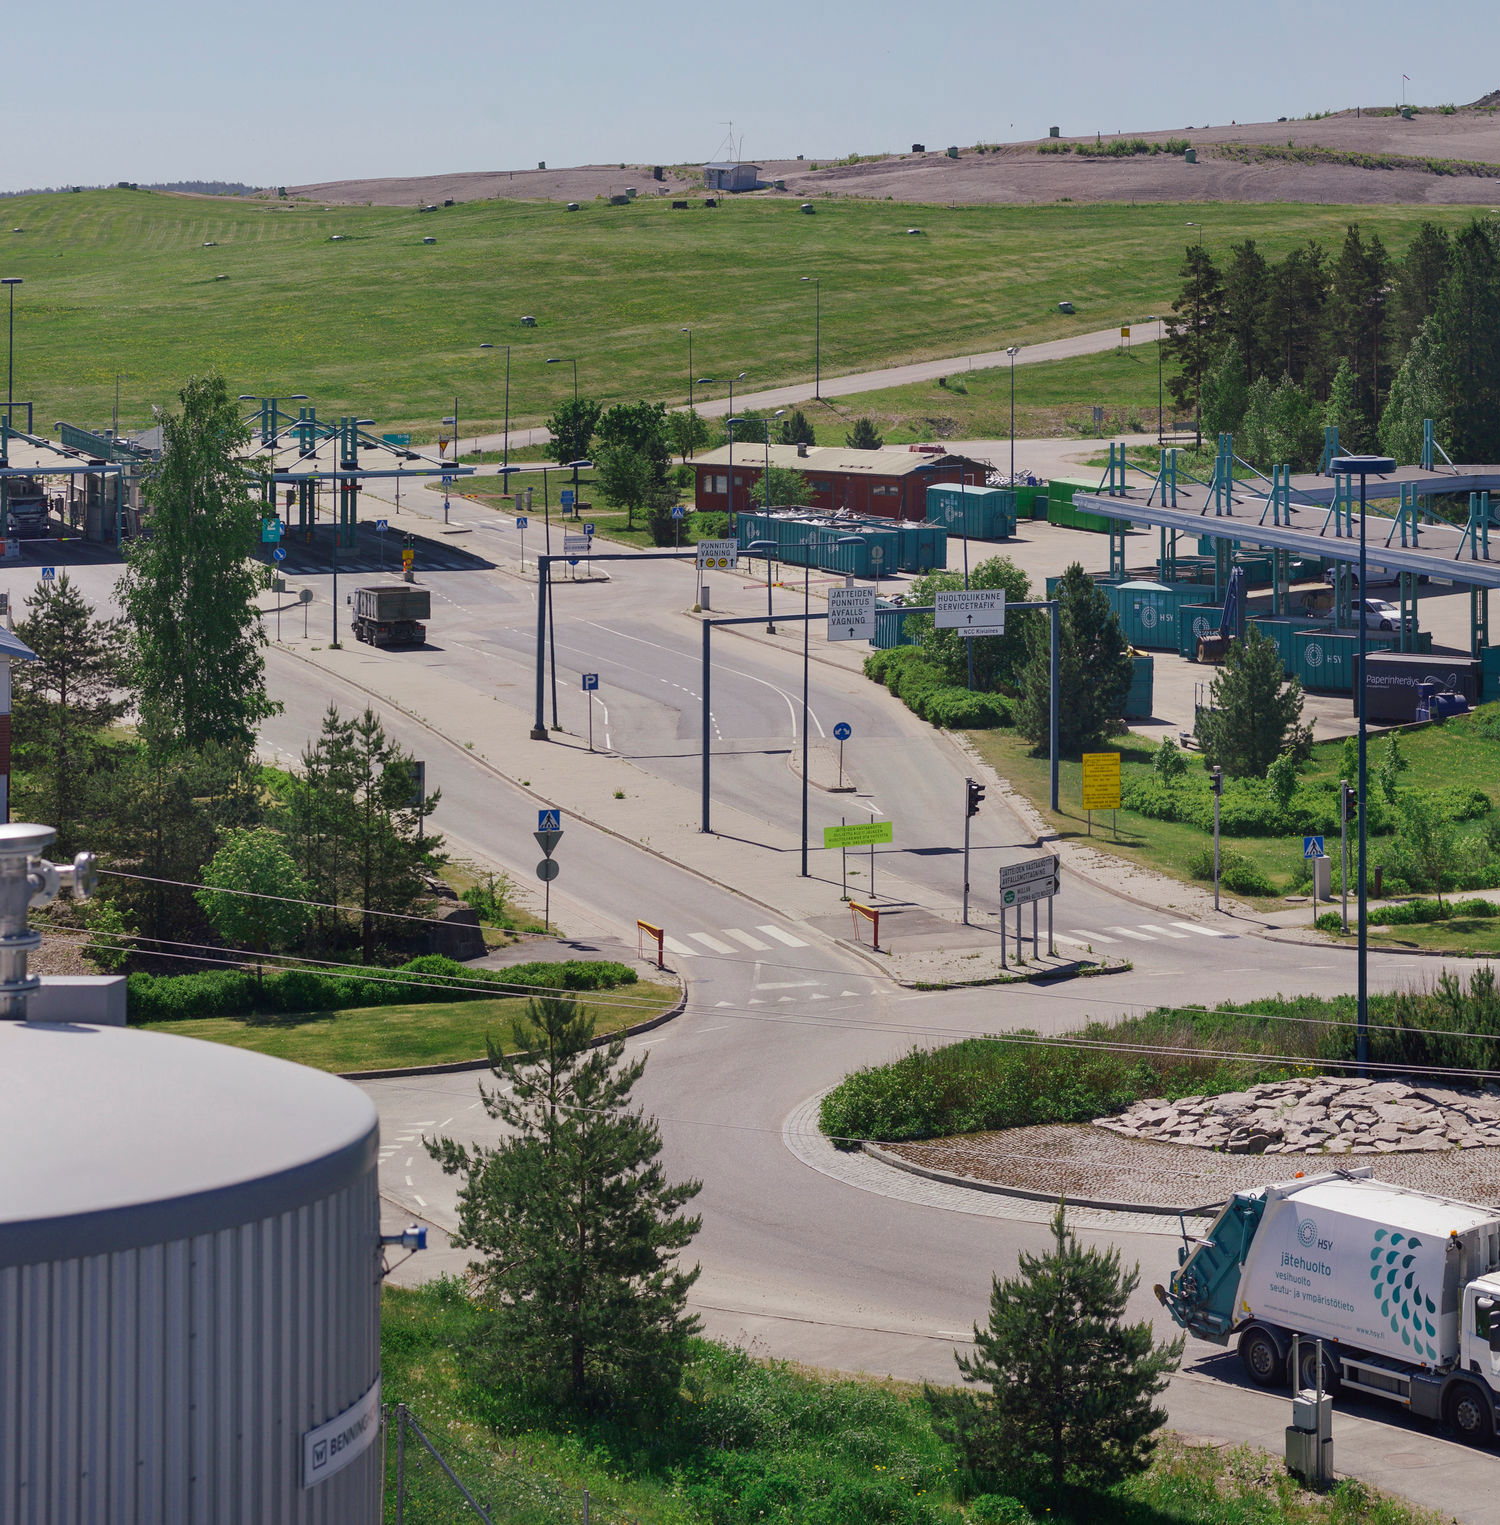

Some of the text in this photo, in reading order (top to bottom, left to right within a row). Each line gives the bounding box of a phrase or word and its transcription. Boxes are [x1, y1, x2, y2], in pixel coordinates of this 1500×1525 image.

[585, 524, 593, 533] P
[938, 592, 1001, 602] HUOLTOLIIKENNE
[831, 598, 870, 607] PUNNITUS
[938, 602, 995, 611] SERVICETRAFIK
[831, 608, 868, 617] AVFALLS-
[1159, 613, 1174, 622] HSY
[1326, 654, 1342, 664] HSY
[585, 675, 596, 690] P
[1317, 1239, 1333, 1251] HSY
[1280, 1251, 1332, 1277] jätehuolto
[1275, 1271, 1311, 1287] vesihuolto
[1269, 1283, 1292, 1295] seutu-
[1293, 1288, 1300, 1299] ja
[1301, 1291, 1355, 1313] ympäristötieto
[1356, 1326, 1385, 1339] www.hsy.fi
